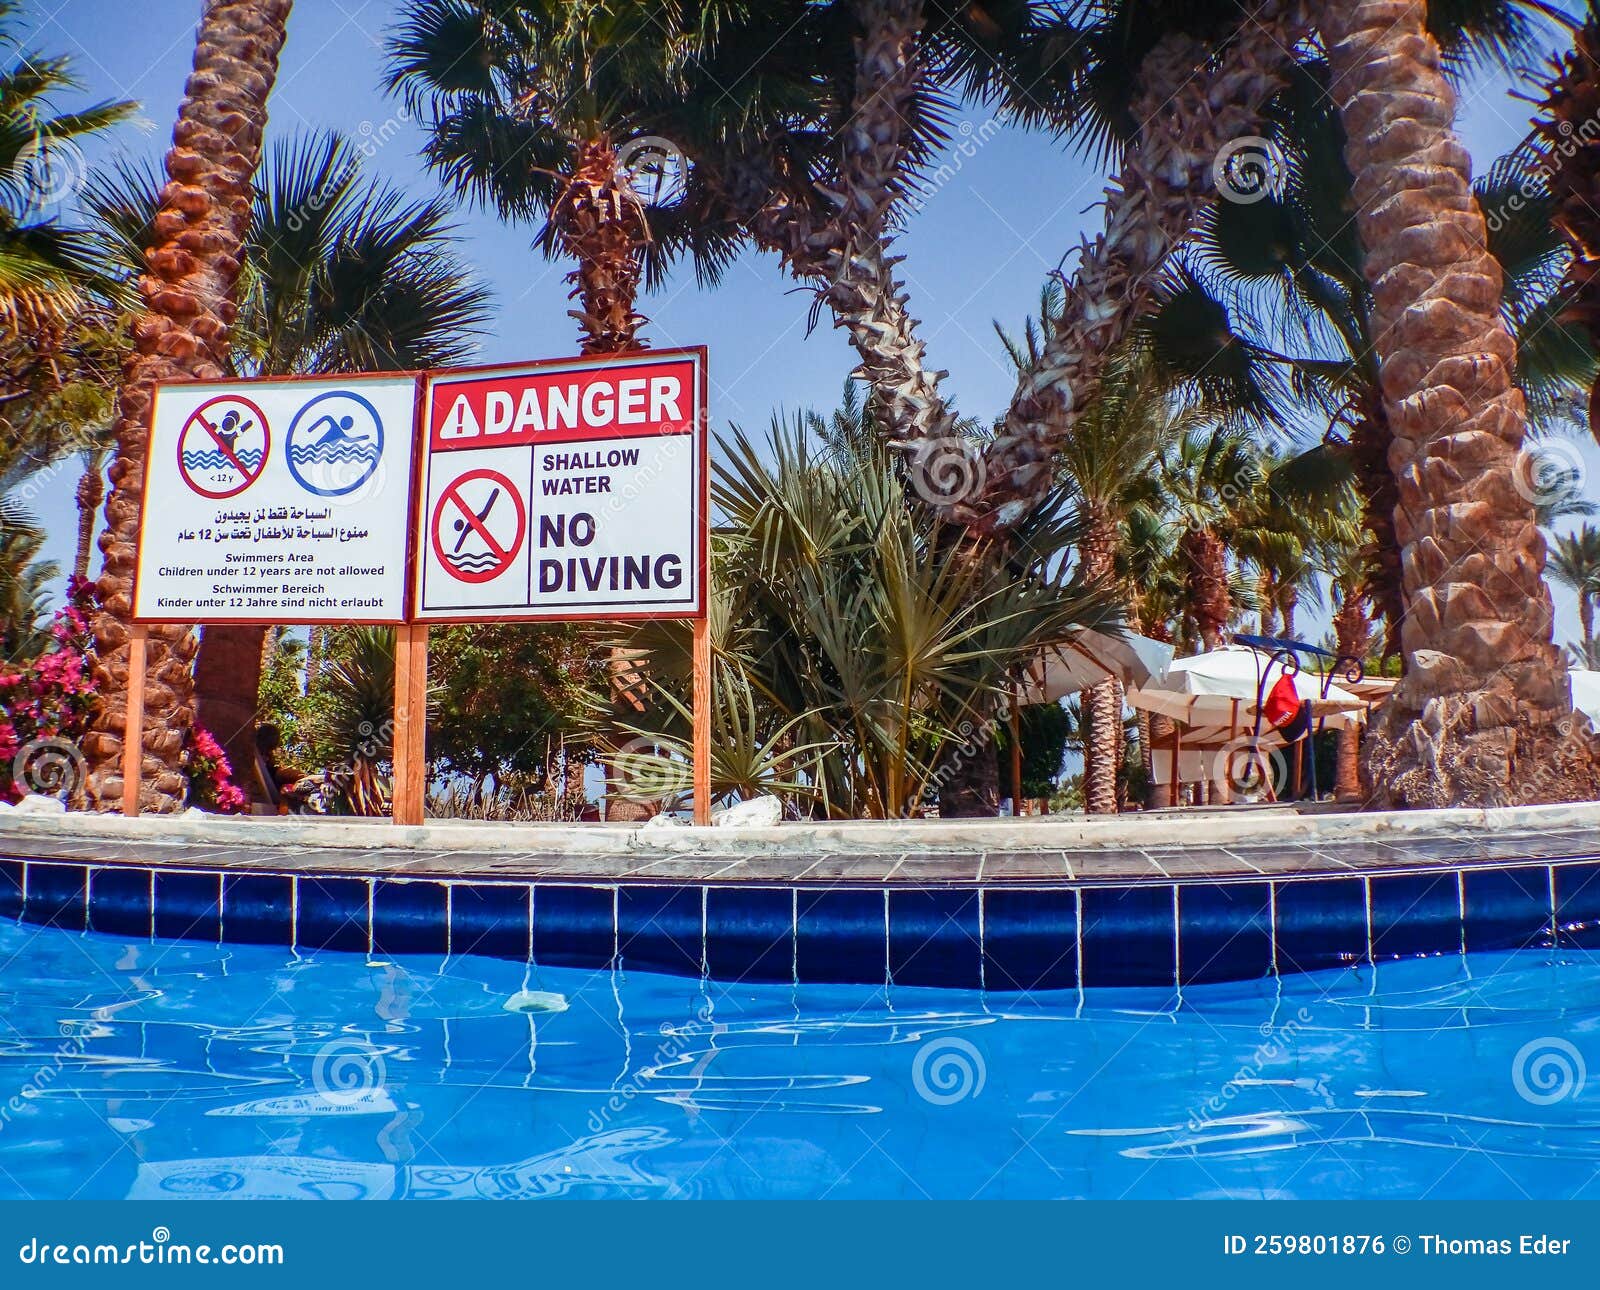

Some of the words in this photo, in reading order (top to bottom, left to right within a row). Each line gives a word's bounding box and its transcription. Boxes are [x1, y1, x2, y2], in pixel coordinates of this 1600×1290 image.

[484, 376, 683, 435] DANGER
[543, 449, 640, 472] SHALLOW
[228, 475, 234, 483] y
[542, 476, 611, 496] WATER
[215, 510, 251, 523] يجيدون
[268, 507, 288, 519] فقط
[290, 506, 331, 522] السباحة
[178, 529, 195, 543] عام
[198, 529, 212, 539] 12
[214, 529, 229, 543] سن
[230, 527, 251, 539] تحت
[253, 525, 294, 542] للأطفال
[296, 526, 338, 541] السباحة
[340, 526, 369, 542] ممنوع
[539, 512, 596, 548] NO
[225, 553, 284, 562] Swimmers
[288, 553, 314, 562] Area
[158, 567, 203, 576] Children
[207, 567, 239, 576] under
[243, 567, 256, 576] 12
[260, 568, 291, 577] years
[294, 568, 313, 576] are
[316, 566, 336, 576] not
[339, 566, 385, 576] allowed
[539, 554, 682, 593] DIVING
[212, 584, 278, 594] Schwimmer
[282, 584, 325, 594] Bereich
[157, 598, 193, 607] Kinder
[196, 598, 226, 607] unter
[230, 598, 243, 607] 12
[246, 598, 278, 607] Jahre
[281, 598, 305, 607] sind
[308, 598, 338, 607] nicht
[341, 598, 384, 607] erlaubt
